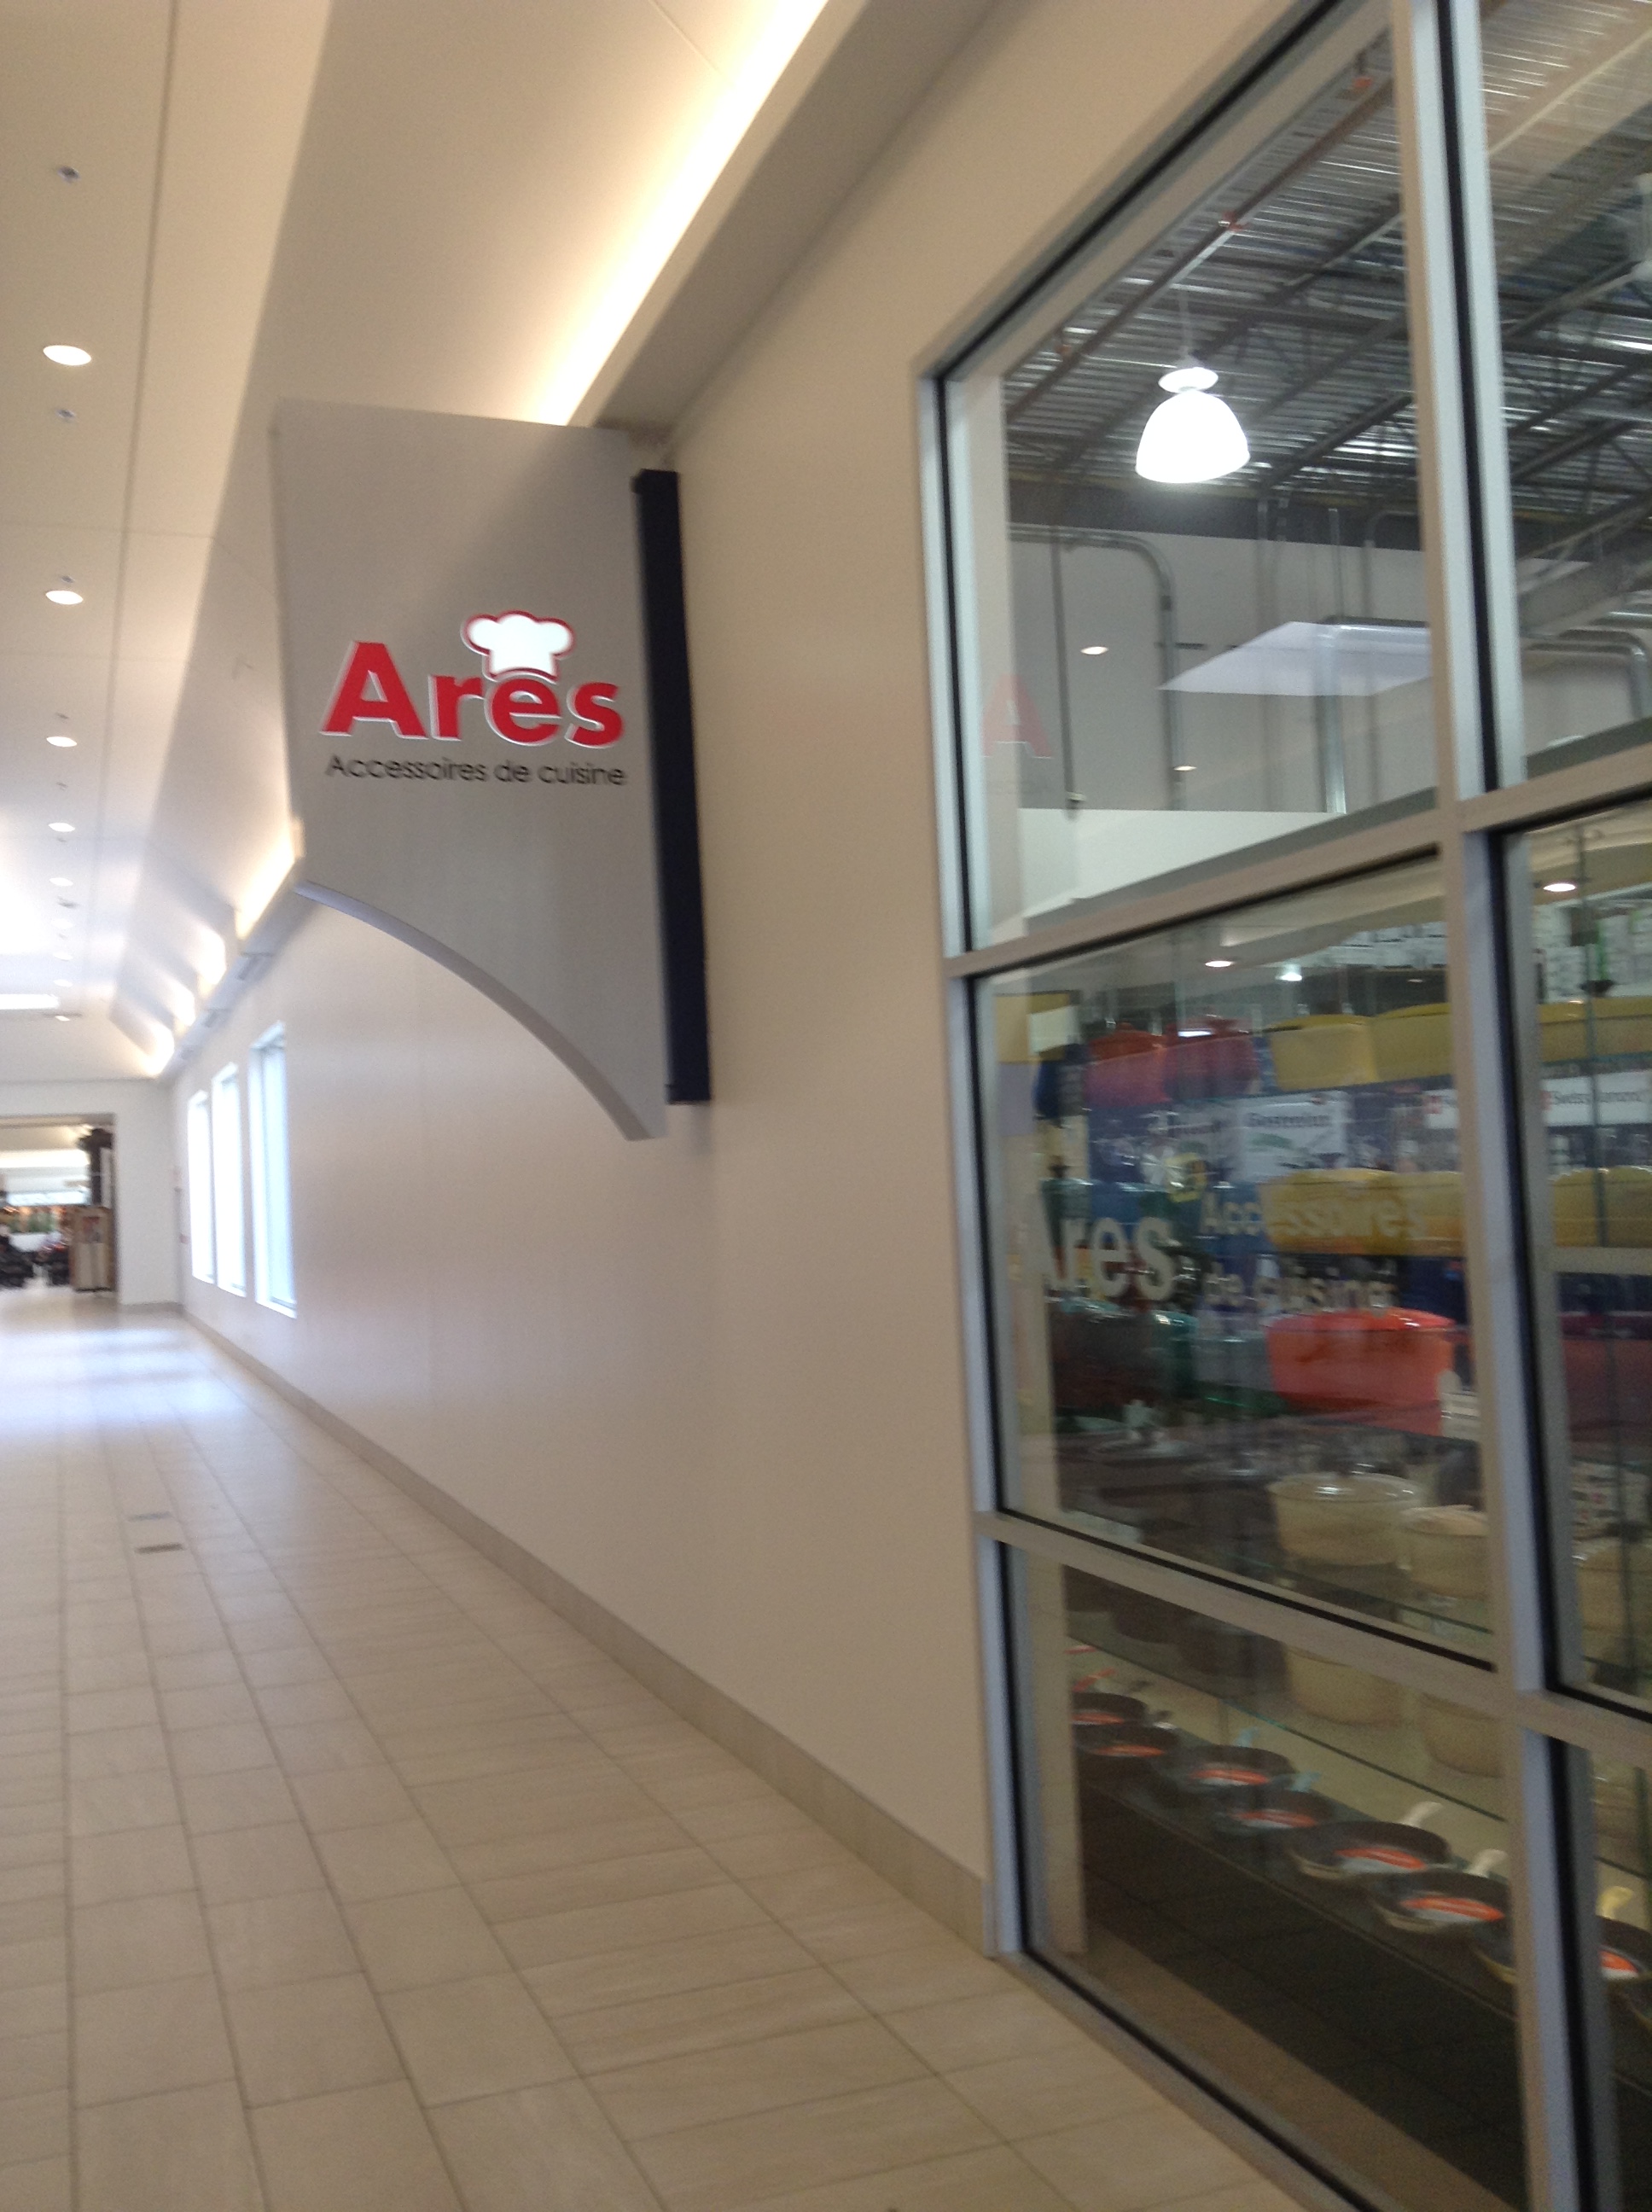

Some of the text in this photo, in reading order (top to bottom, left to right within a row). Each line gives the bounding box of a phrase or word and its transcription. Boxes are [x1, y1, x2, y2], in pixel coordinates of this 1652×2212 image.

[320, 640, 625, 748] Ares
[326, 755, 626, 787] Accessoires de cuisine
